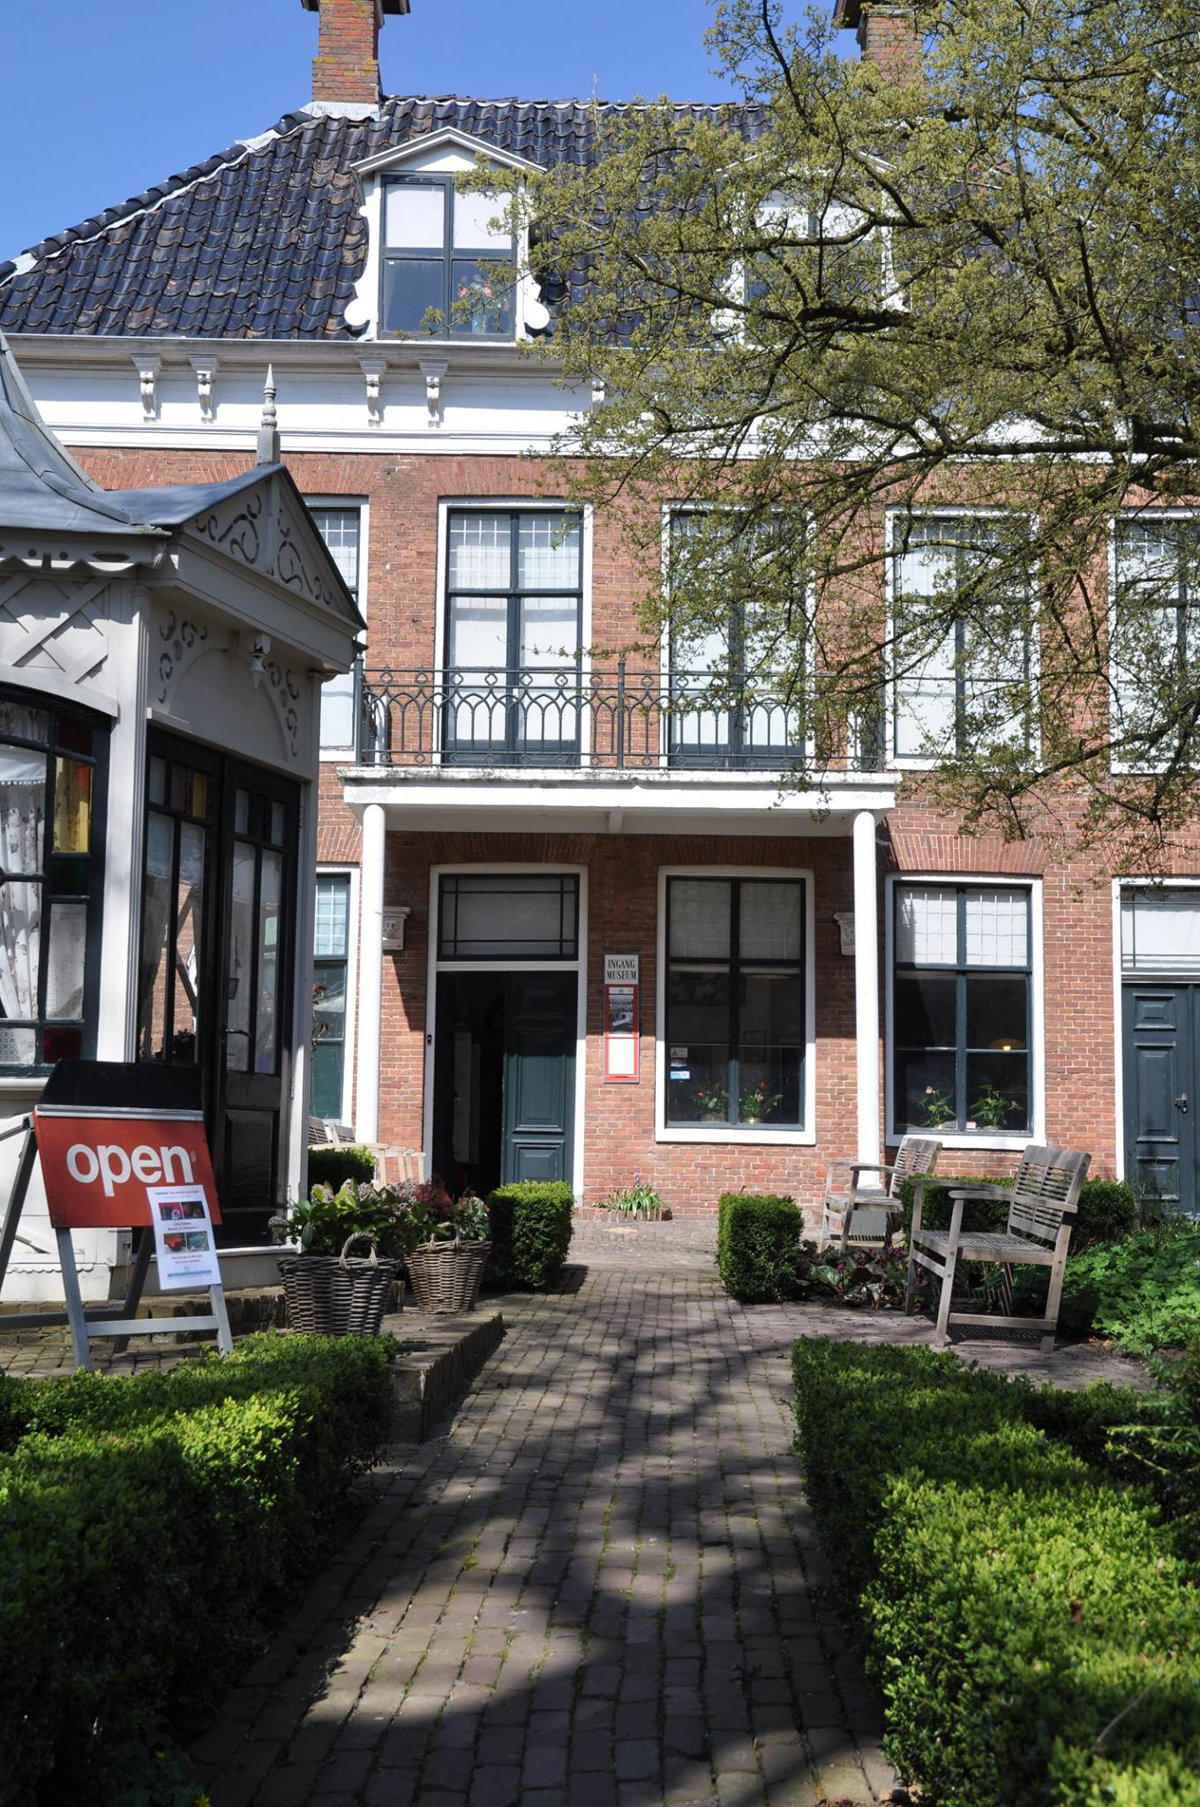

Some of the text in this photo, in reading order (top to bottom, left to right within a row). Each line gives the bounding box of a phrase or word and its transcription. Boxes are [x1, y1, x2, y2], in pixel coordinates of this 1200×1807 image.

[607, 959, 636, 969] INGANG
[606, 970, 637, 980] MUSEUM
[66, 1143, 194, 1197] open
